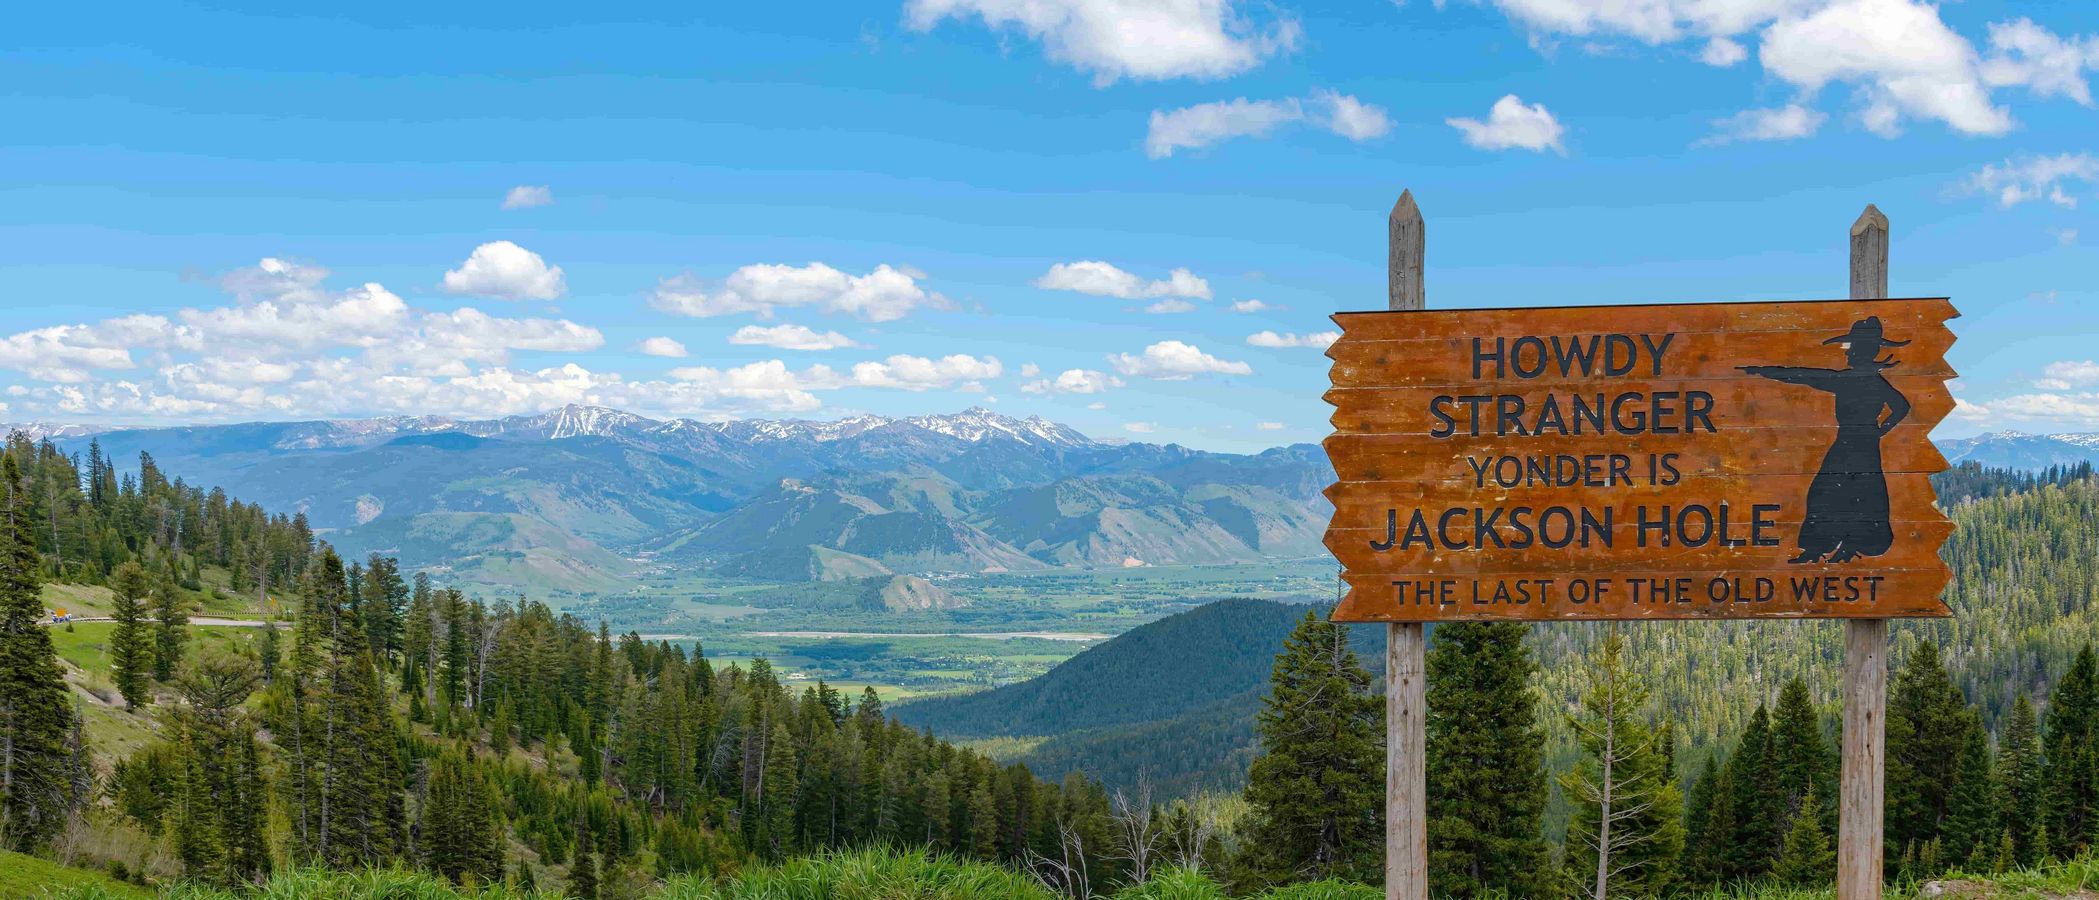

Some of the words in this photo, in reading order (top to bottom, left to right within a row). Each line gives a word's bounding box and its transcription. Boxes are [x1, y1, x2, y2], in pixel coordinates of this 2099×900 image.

[1472, 333, 1676, 380] HOWDY
[1429, 390, 1718, 439] STRANGER
[1467, 452, 1634, 489] YONDER
[1648, 452, 1681, 487] IS
[1369, 505, 1614, 552] JACKSON
[1637, 503, 1781, 549] HOLE
[1391, 579, 1457, 606] THE
[1472, 578, 1555, 605] LAST
[1567, 577, 1613, 605] OF
[1625, 577, 1693, 604] THE
[1706, 576, 1775, 604] OLD
[1789, 575, 1885, 603] WEST
